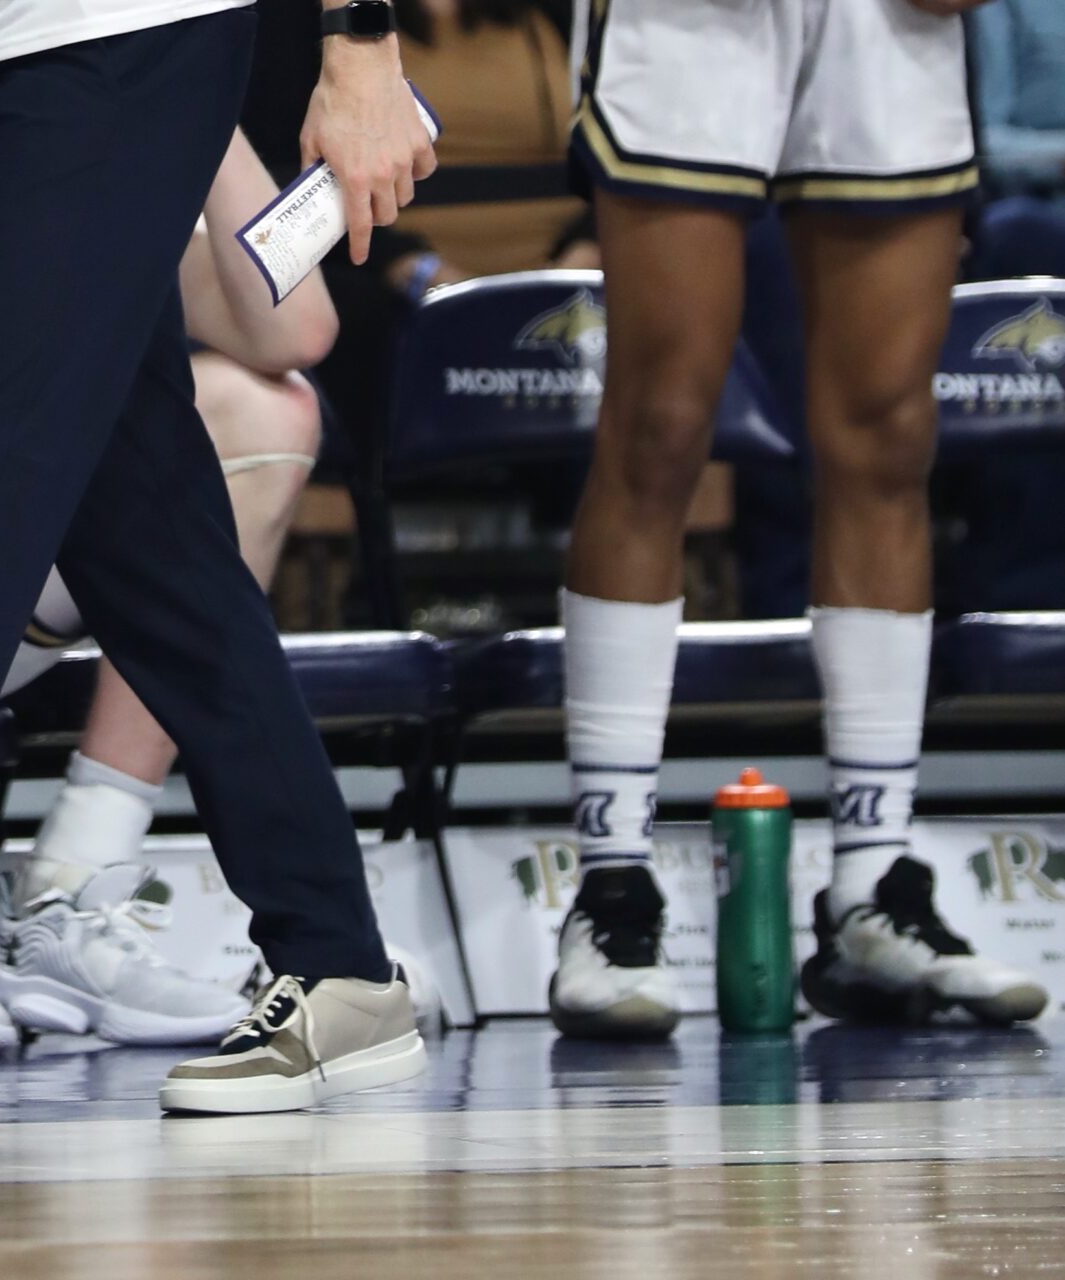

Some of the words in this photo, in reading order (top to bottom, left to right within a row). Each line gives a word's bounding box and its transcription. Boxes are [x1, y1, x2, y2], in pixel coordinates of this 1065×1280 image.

[276, 175, 329, 224] BASKETBALL
[445, 368, 604, 396] MONTANA
[931, 372, 1064, 401] ONTANA
